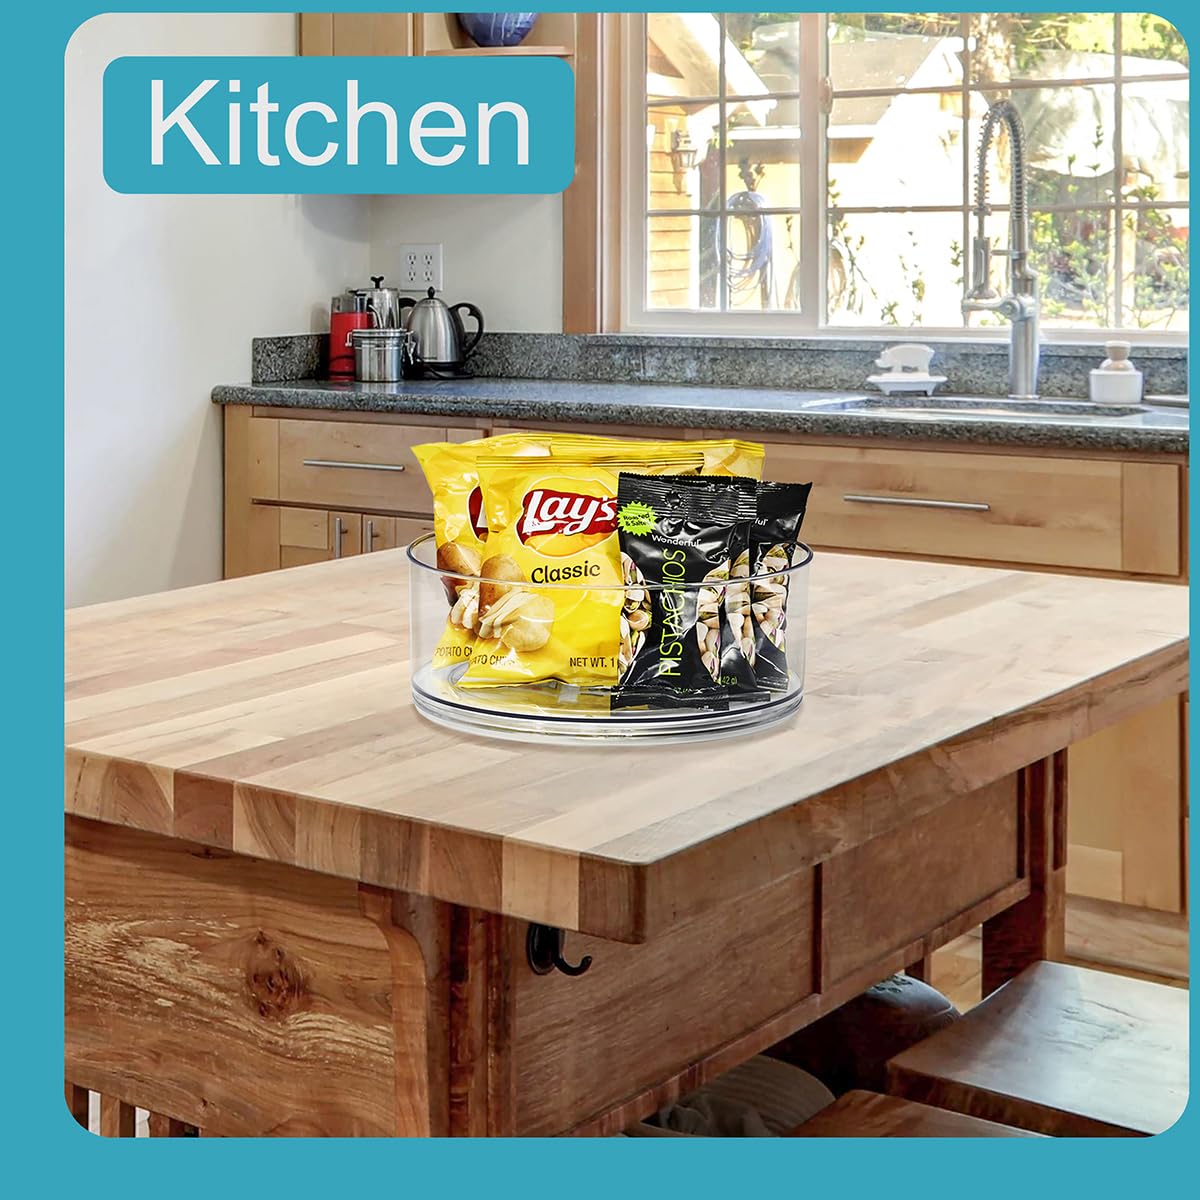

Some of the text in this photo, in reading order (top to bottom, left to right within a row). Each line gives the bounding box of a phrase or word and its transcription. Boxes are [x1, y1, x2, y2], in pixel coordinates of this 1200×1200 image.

[522, 490, 617, 536] Lay's
[651, 534, 700, 548] Wonderful
[531, 560, 600, 584] Classic
[658, 548, 686, 676] PISTACHIOS
[436, 646, 462, 657] POTATO
[570, 657, 588, 667] NET
[590, 658, 607, 668] WT.
